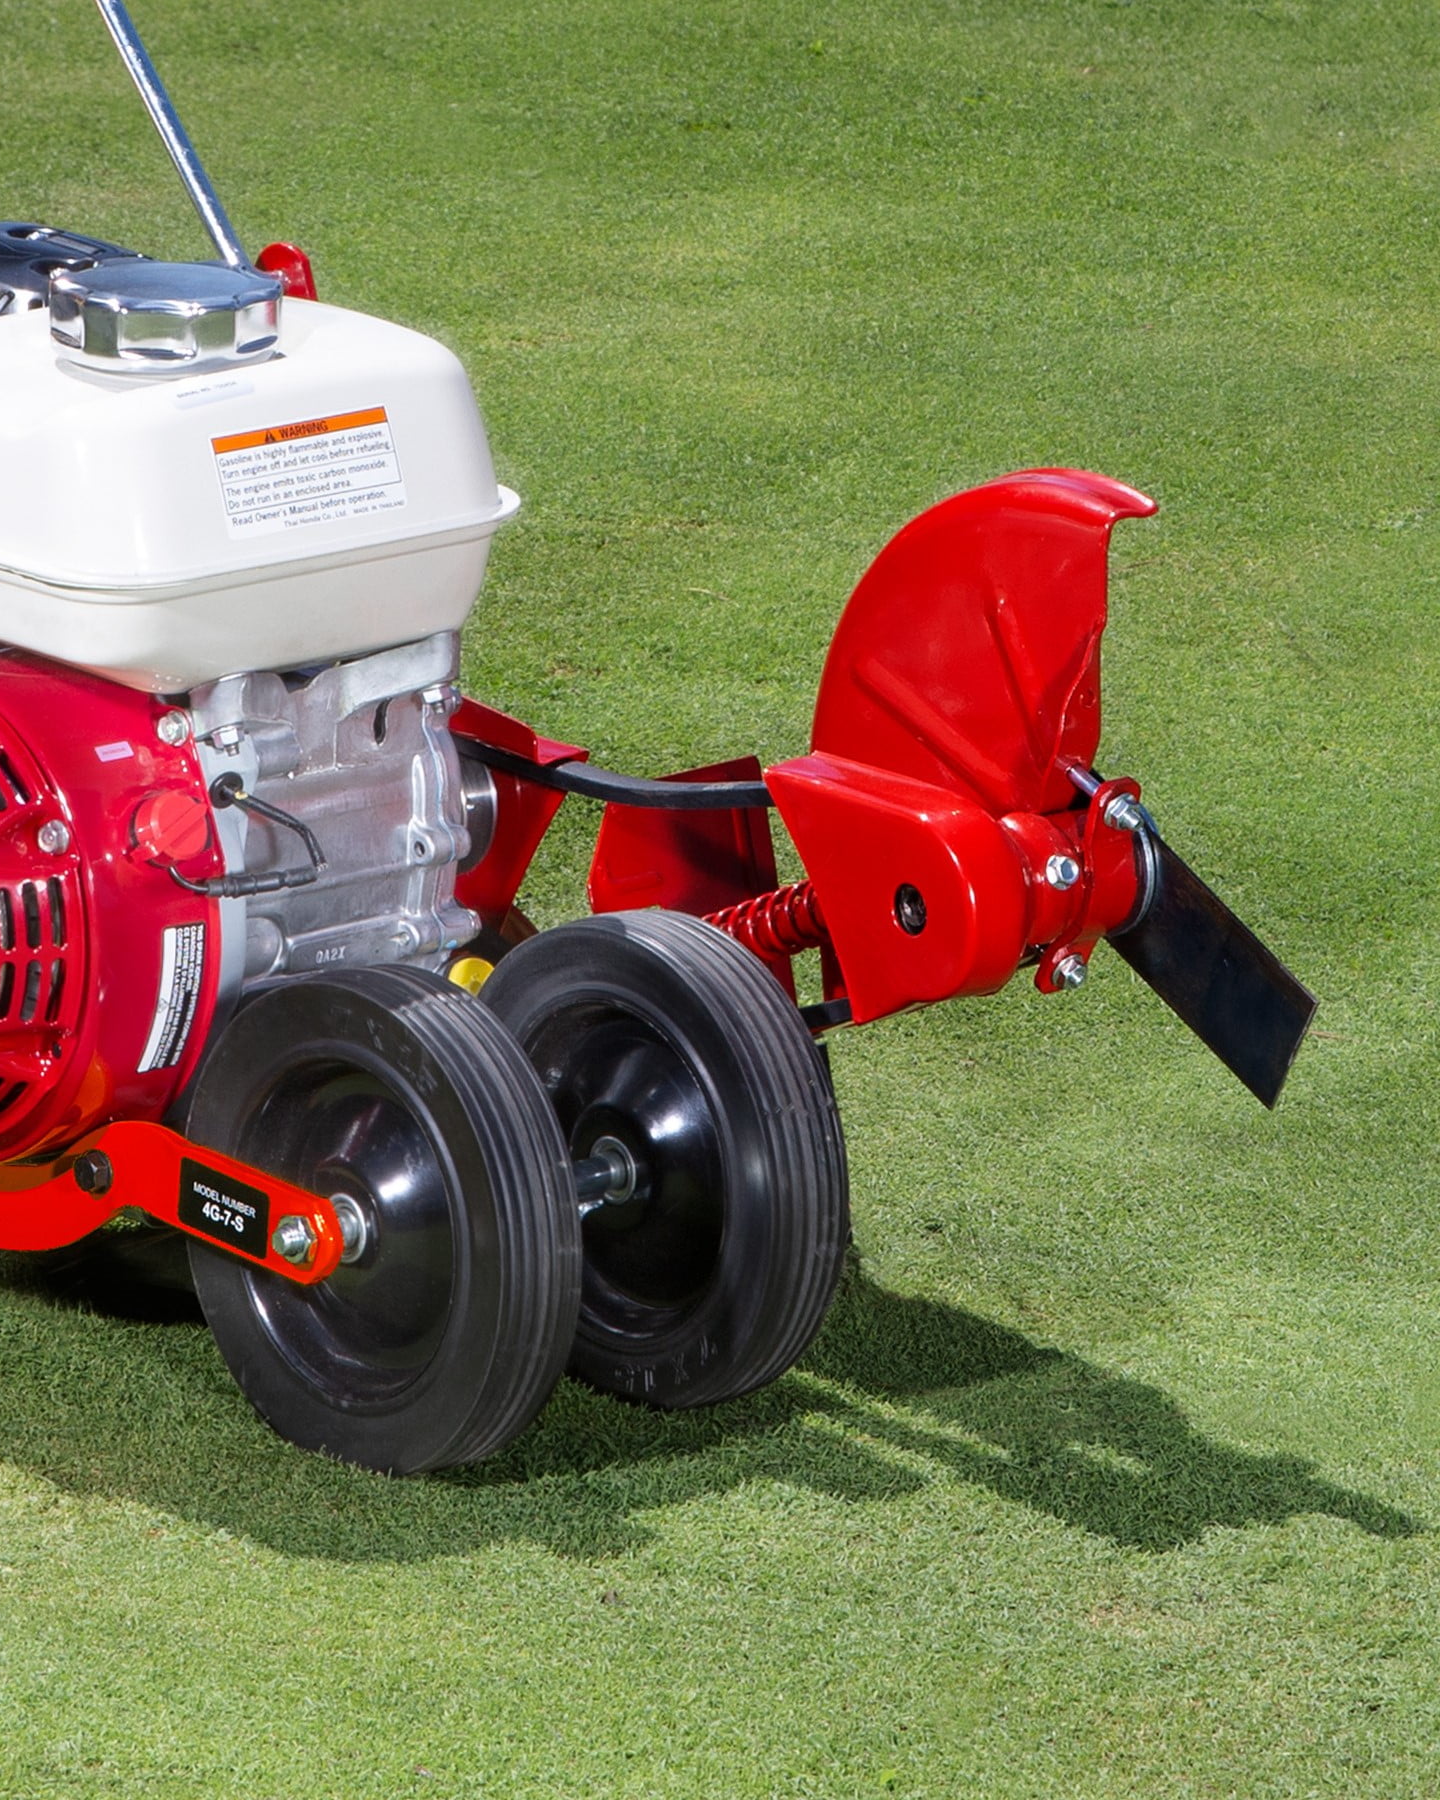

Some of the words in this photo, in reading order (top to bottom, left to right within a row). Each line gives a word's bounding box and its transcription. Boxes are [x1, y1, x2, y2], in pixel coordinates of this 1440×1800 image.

[279, 421, 328, 439] WARNING
[219, 452, 252, 467] Gasoline
[255, 452, 262, 461] is
[263, 447, 287, 460] highly
[288, 440, 329, 454] flammable
[331, 436, 346, 446] and
[222, 469, 240, 480] Turn
[242, 464, 268, 476] engine
[270, 460, 281, 471] off
[283, 457, 298, 468] and
[329, 447, 354, 460] before
[226, 487, 241, 498] The
[244, 482, 270, 495] engine
[318, 467, 346, 480] carbon
[228, 499, 240, 510] Do
[242, 496, 255, 507] not
[257, 495, 271, 505] run
[283, 490, 294, 500] an
[295, 483, 331, 497] enclosed
[232, 515, 253, 527] Read
[289, 502, 319, 515] Manual
[320, 497, 346, 510] before
[193, 1181, 220, 1203] MODEL
[221, 1194, 256, 1219] NUMBER
[202, 1202, 244, 1233] 4G-7-S
